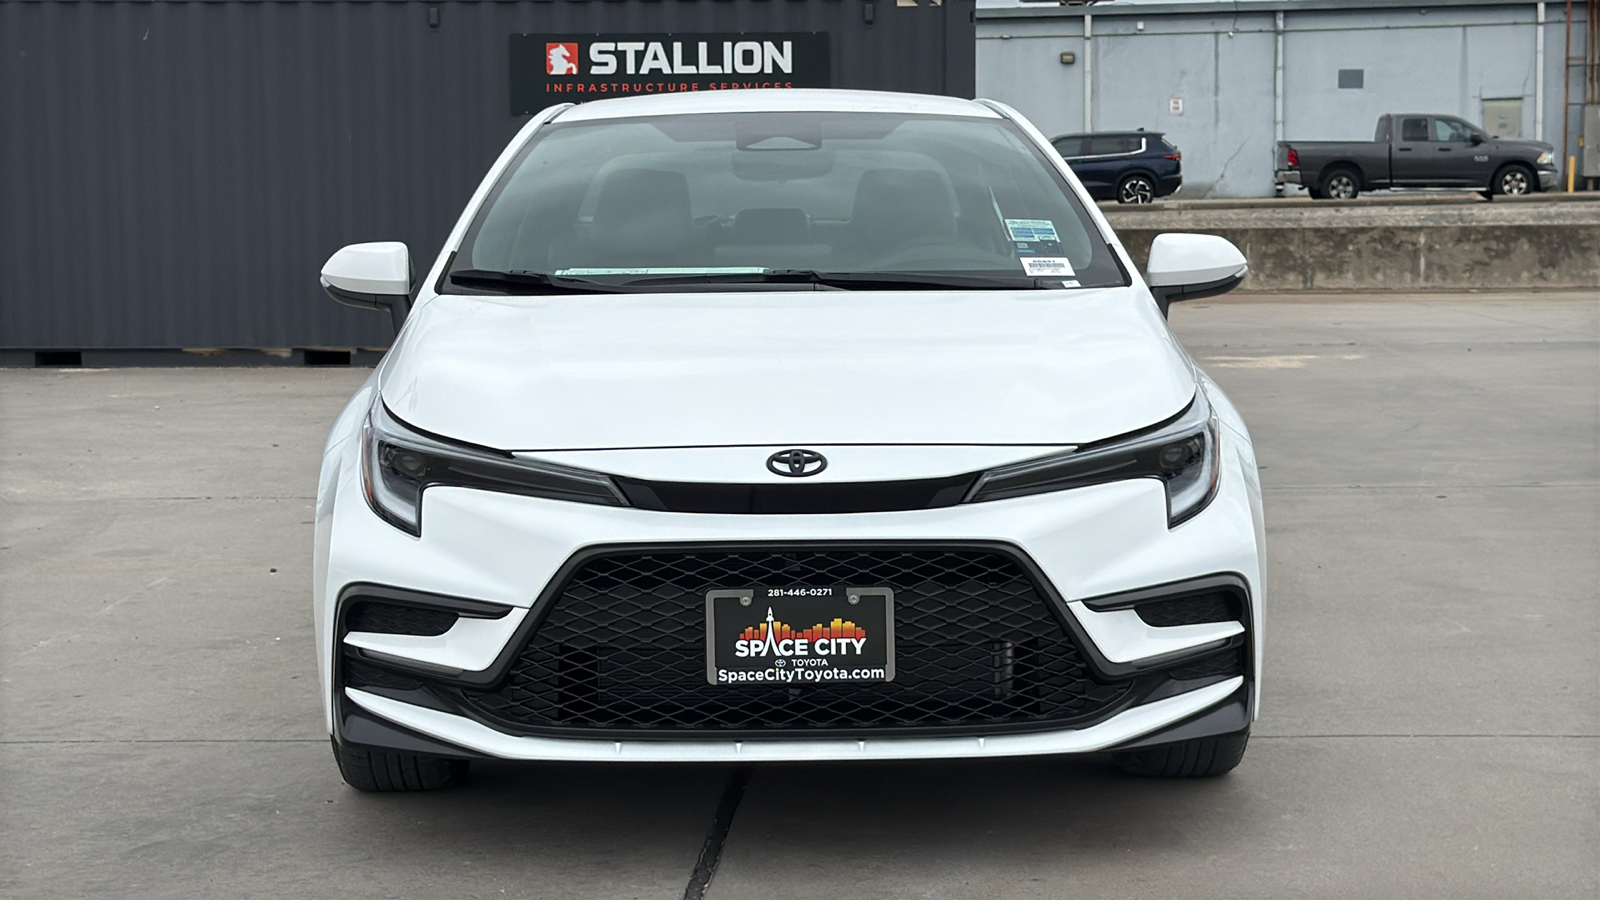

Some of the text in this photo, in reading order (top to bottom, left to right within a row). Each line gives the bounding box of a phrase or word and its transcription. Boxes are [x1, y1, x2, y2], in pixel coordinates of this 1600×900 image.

[589, 41, 793, 75] STALLION
[546, 82, 792, 93] INFRASTRUCTURE SERVICES
[767, 588, 832, 597] 281-446-0271
[735, 638, 867, 657] SPACE CITY
[791, 658, 829, 667] TOYOTA
[718, 667, 885, 684] SpaceCityToyota.com
